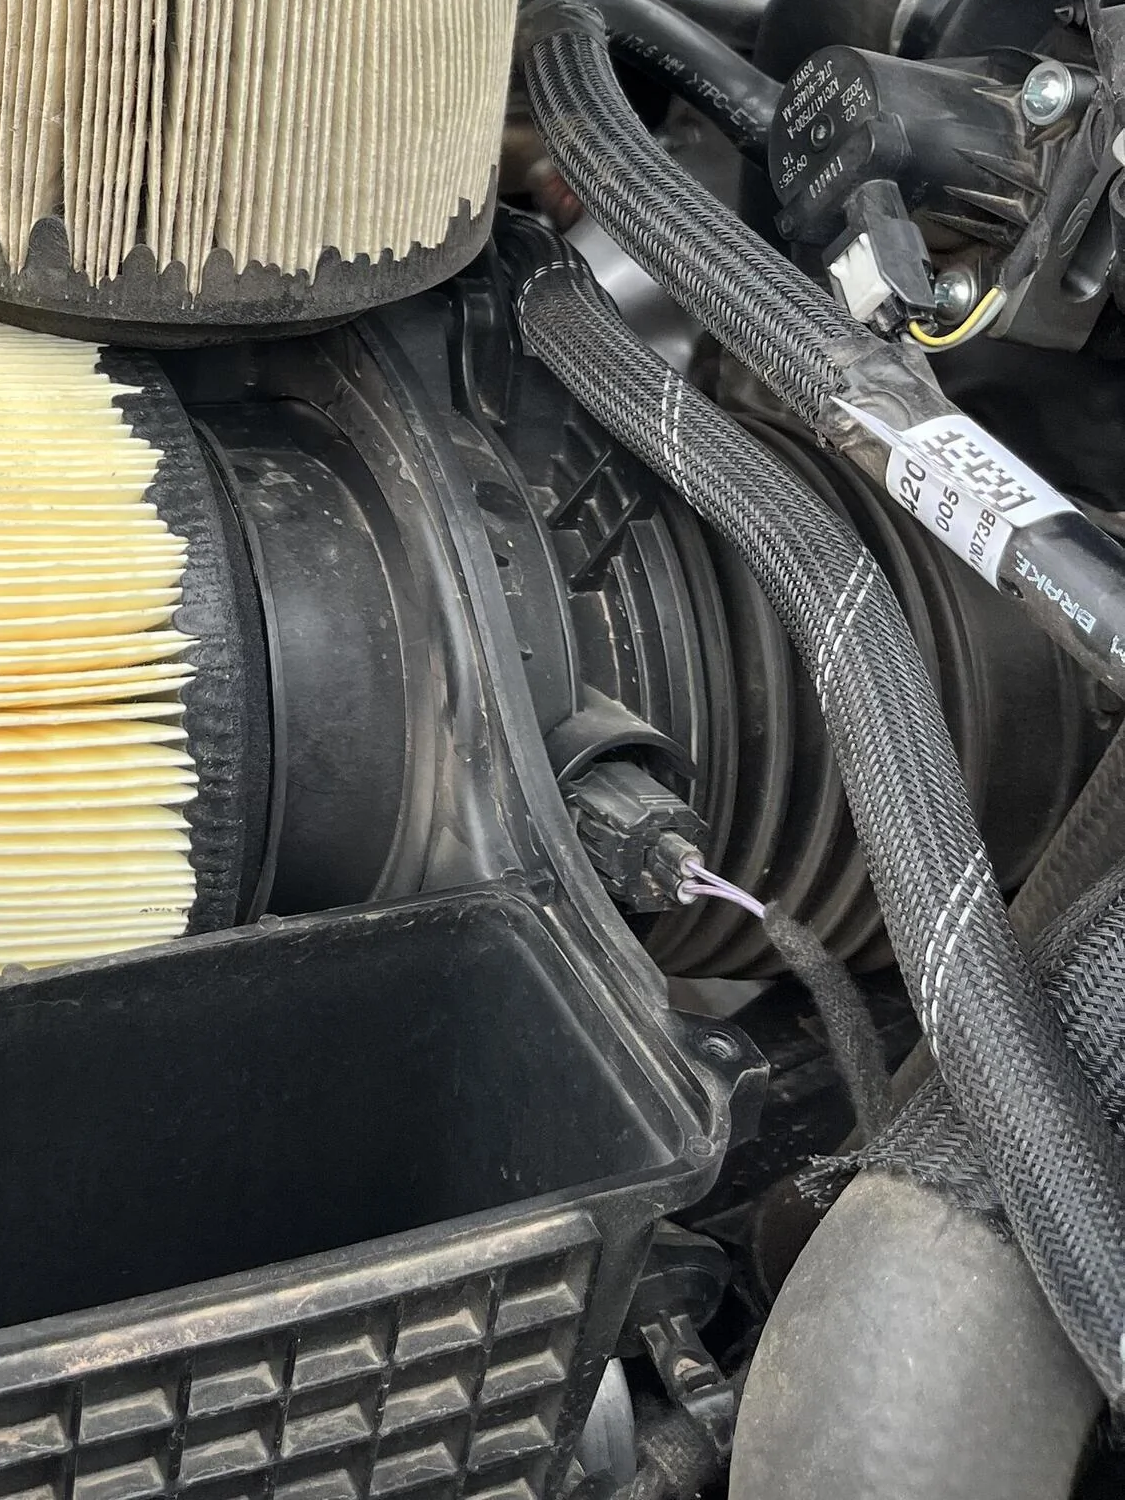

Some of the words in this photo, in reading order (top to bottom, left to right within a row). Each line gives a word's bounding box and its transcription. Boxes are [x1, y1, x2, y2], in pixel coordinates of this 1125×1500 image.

[839, 76, 864, 107] 2022
[934, 486, 960, 533] 005
[1014, 550, 1098, 635] BRAKE
